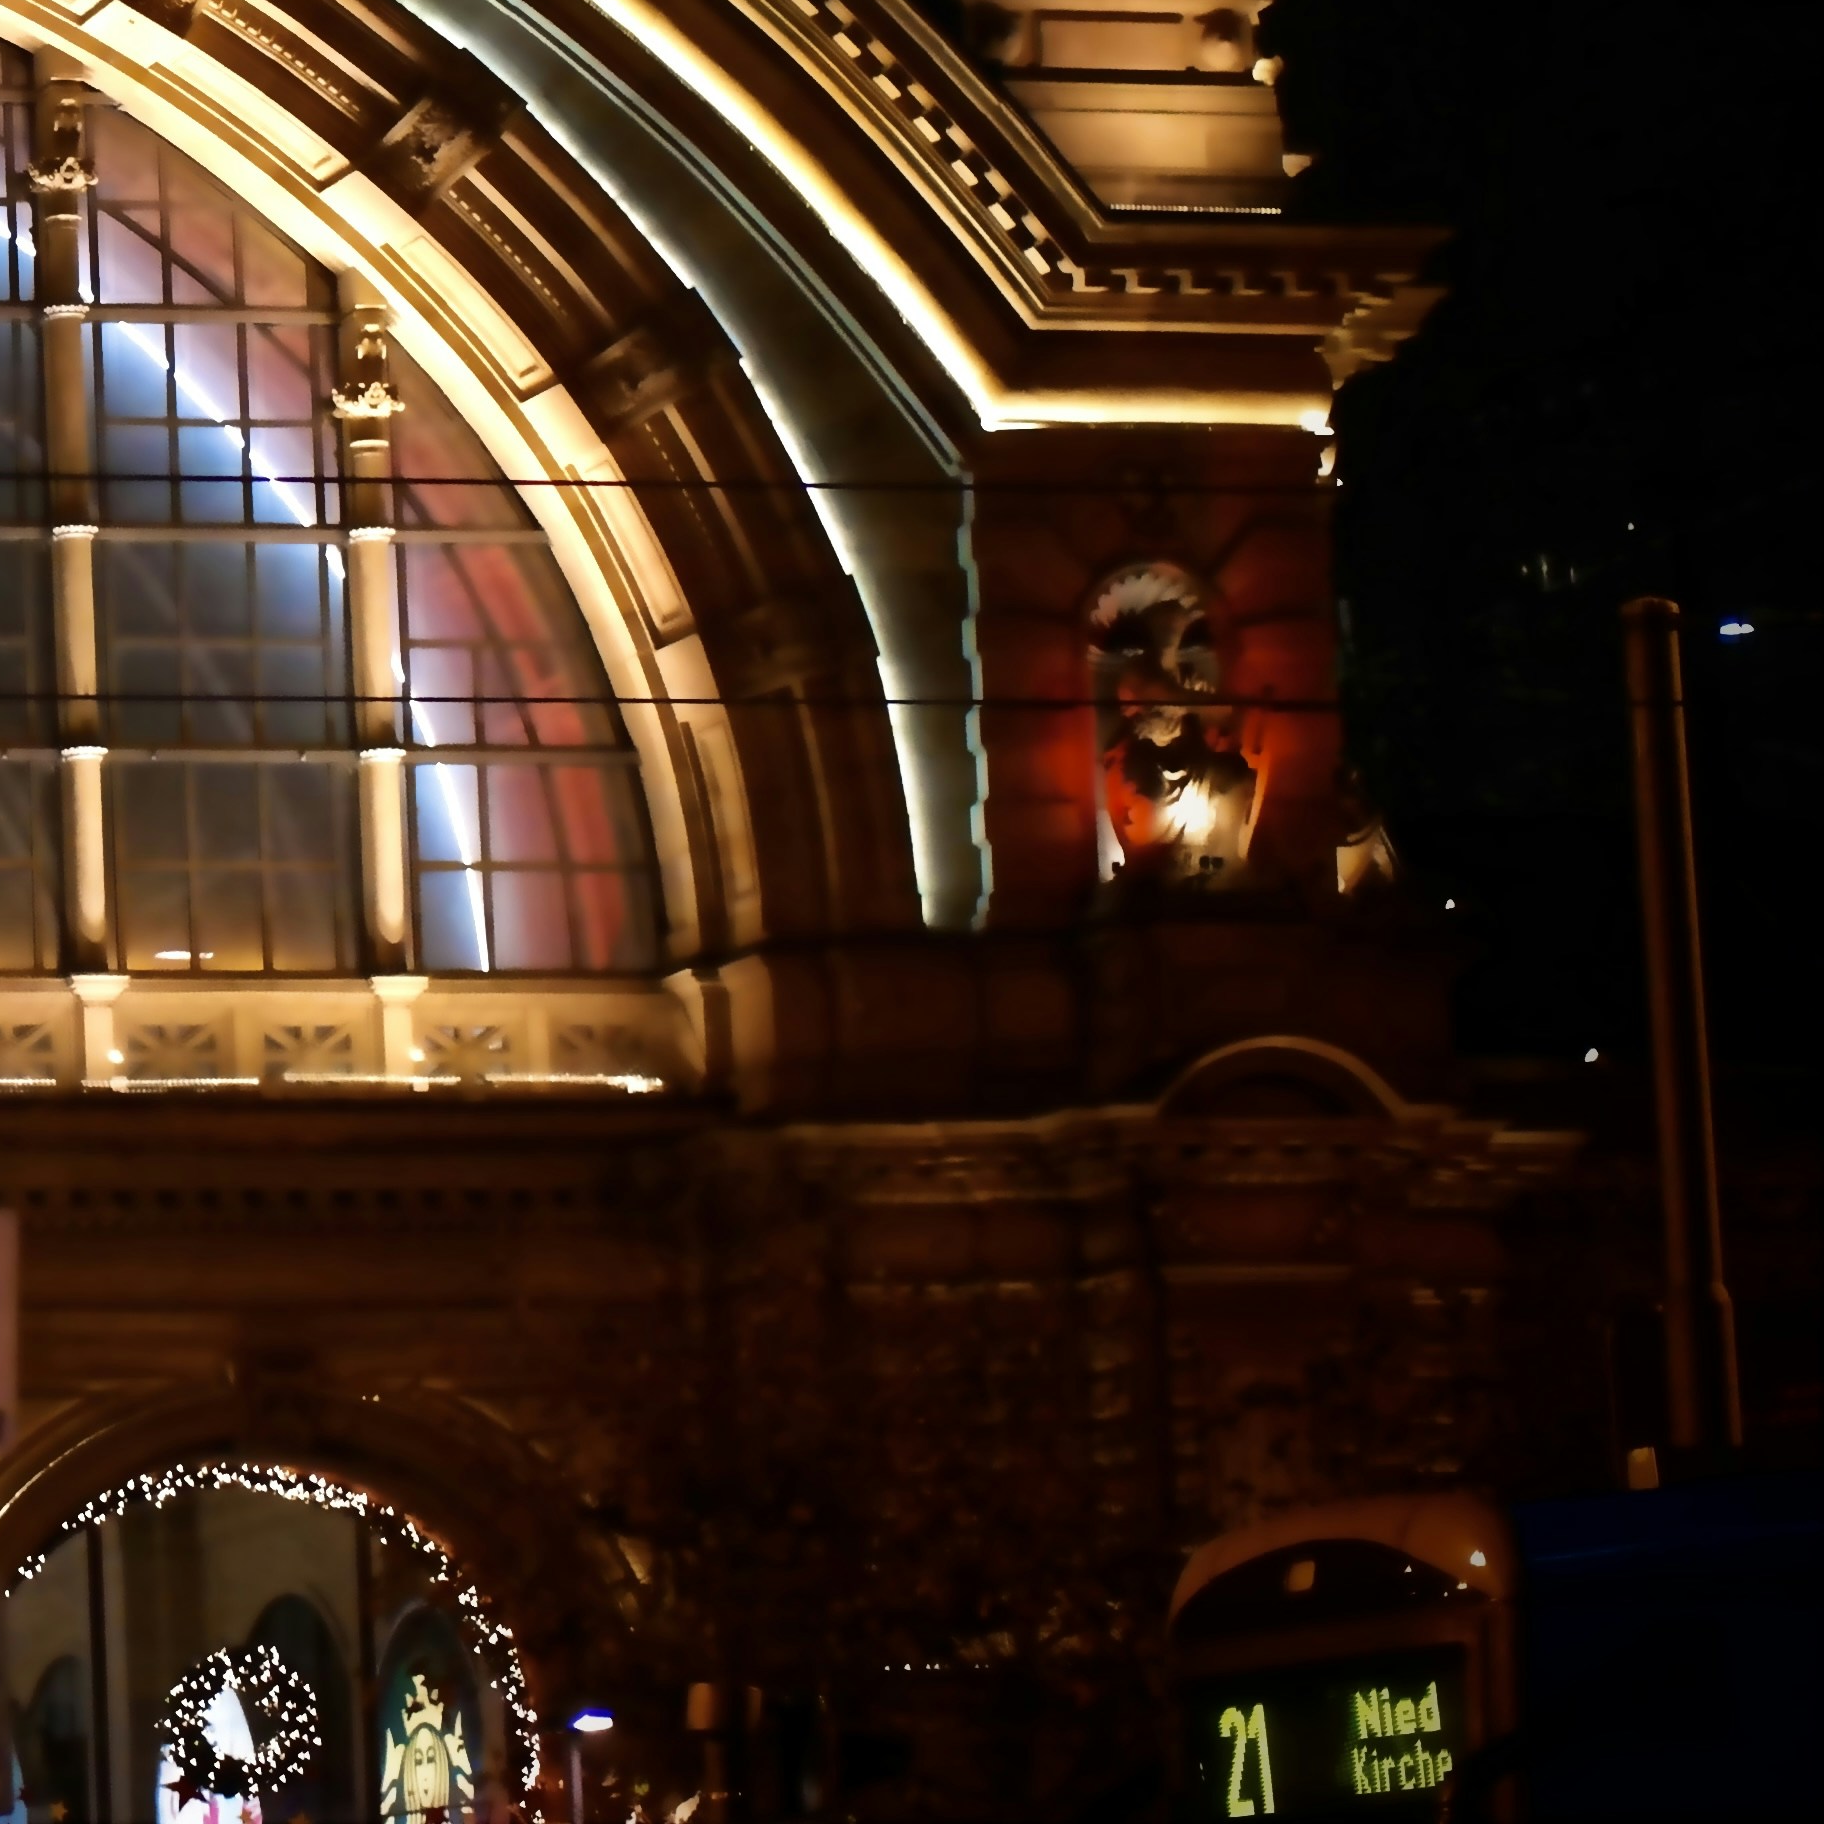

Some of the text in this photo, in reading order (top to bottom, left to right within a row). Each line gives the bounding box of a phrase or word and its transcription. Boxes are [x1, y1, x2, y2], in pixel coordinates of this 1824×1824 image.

[1351, 1680, 1442, 1740] Nied
[1217, 1702, 1275, 1818] 21
[1350, 1738, 1453, 1795] Kirche
